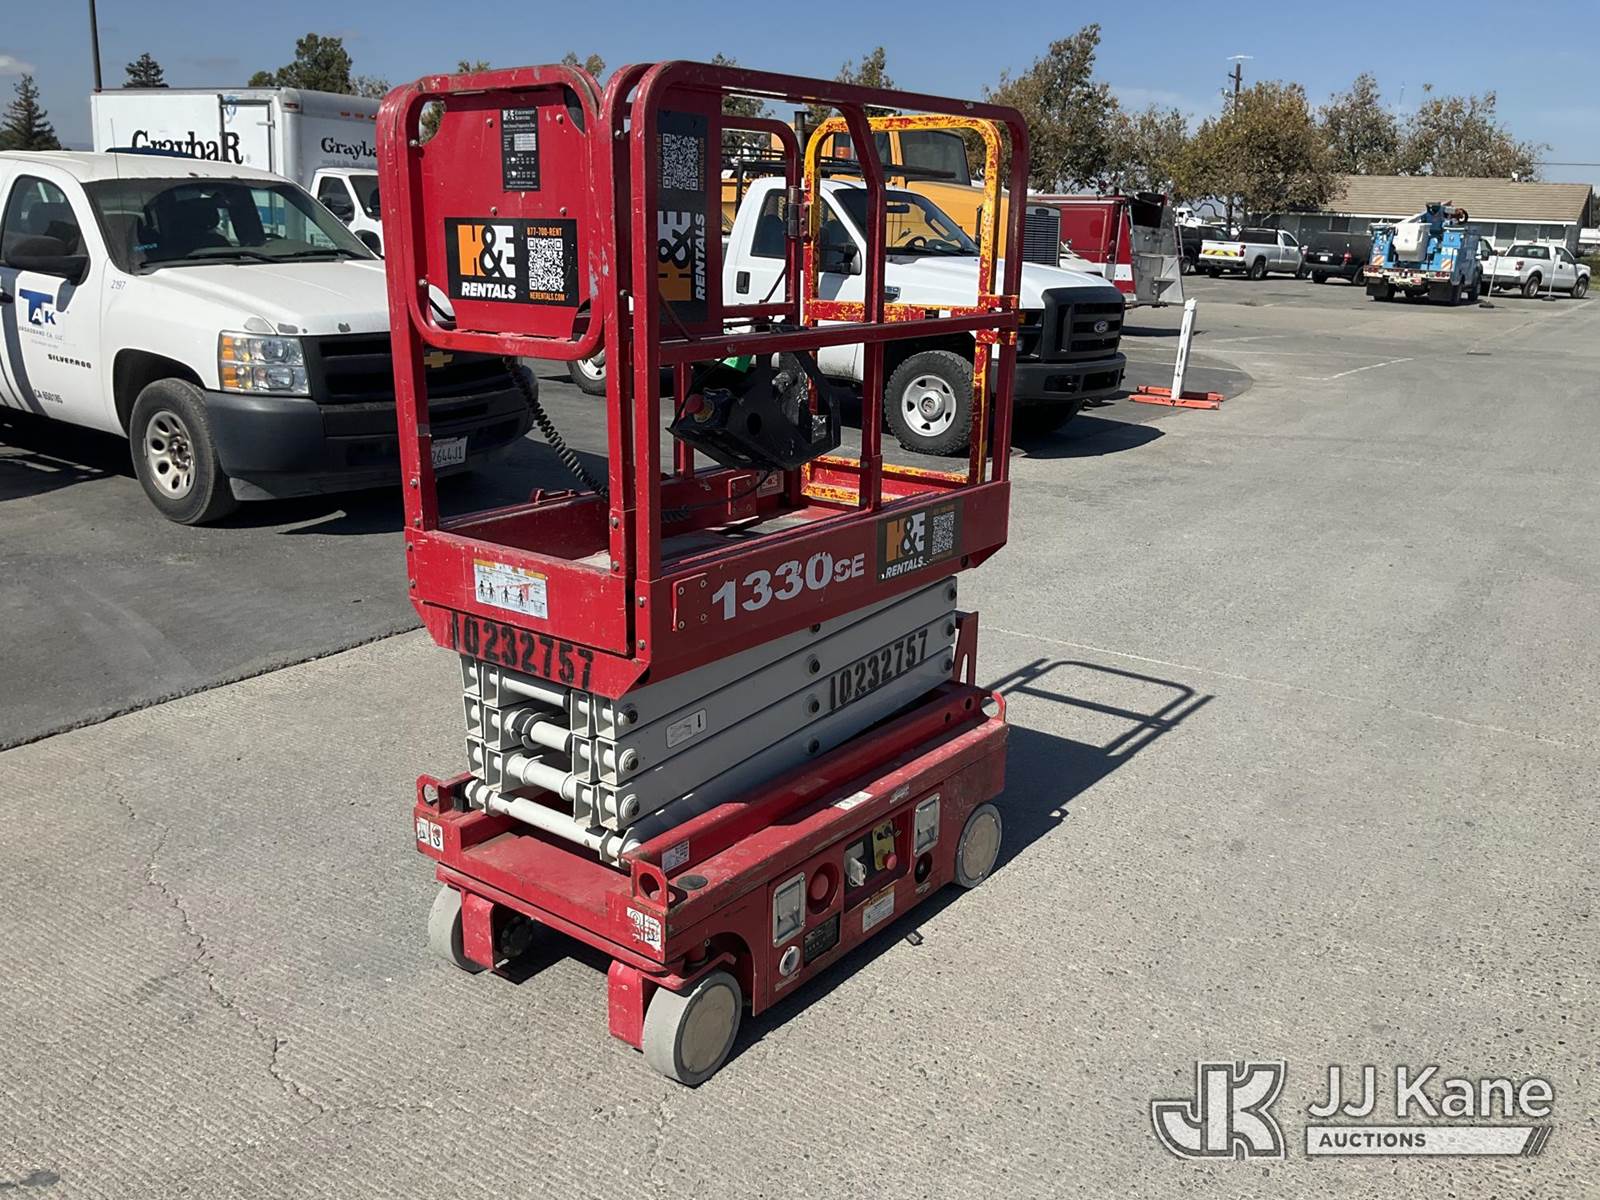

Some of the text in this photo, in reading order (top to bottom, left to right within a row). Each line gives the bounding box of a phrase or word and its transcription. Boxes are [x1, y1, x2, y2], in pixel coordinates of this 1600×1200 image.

[457, 224, 516, 278] H&E
[657, 211, 691, 300] H&E
[694, 212, 706, 300] RENTALS
[461, 281, 517, 299] RENTALS
[48, 353, 92, 369] SILVERADO
[886, 512, 926, 562] H&E
[885, 556, 925, 579] RENTALS
[452, 609, 595, 690] 10232757
[830, 629, 928, 710] 10232757
